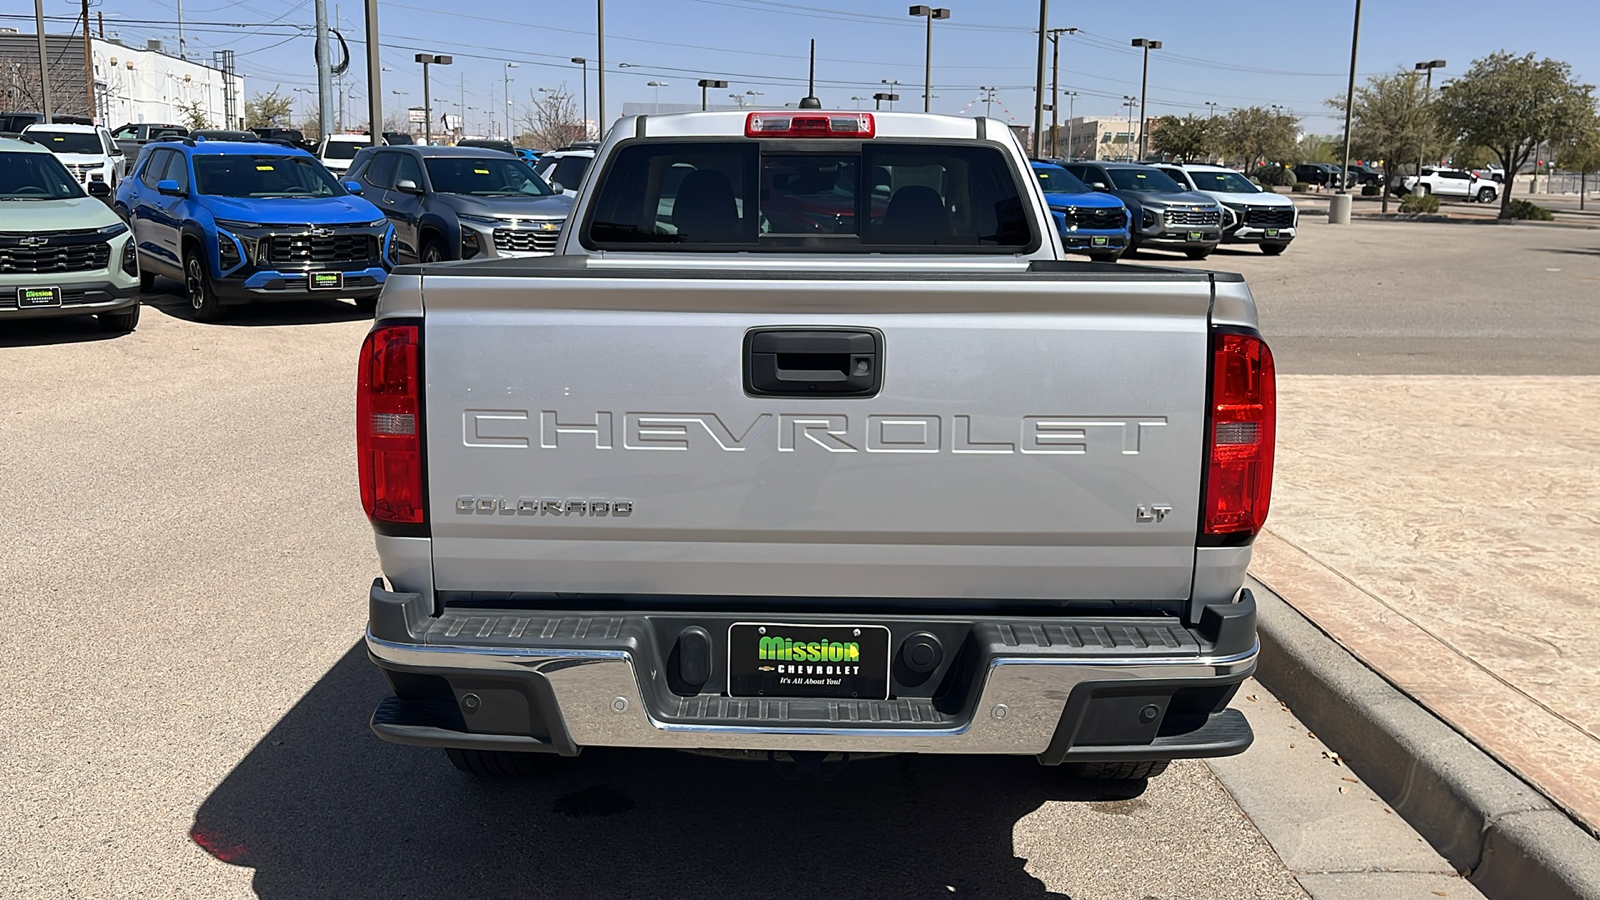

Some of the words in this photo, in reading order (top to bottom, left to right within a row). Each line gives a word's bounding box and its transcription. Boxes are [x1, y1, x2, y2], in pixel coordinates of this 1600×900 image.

[462, 409, 1168, 455] CHEVROLET
[456, 496, 634, 516] COLORADO
[1136, 504, 1173, 523] LT
[758, 636, 860, 662] Mission
[777, 665, 860, 675] CHEVROLET
[792, 677, 803, 685] All
